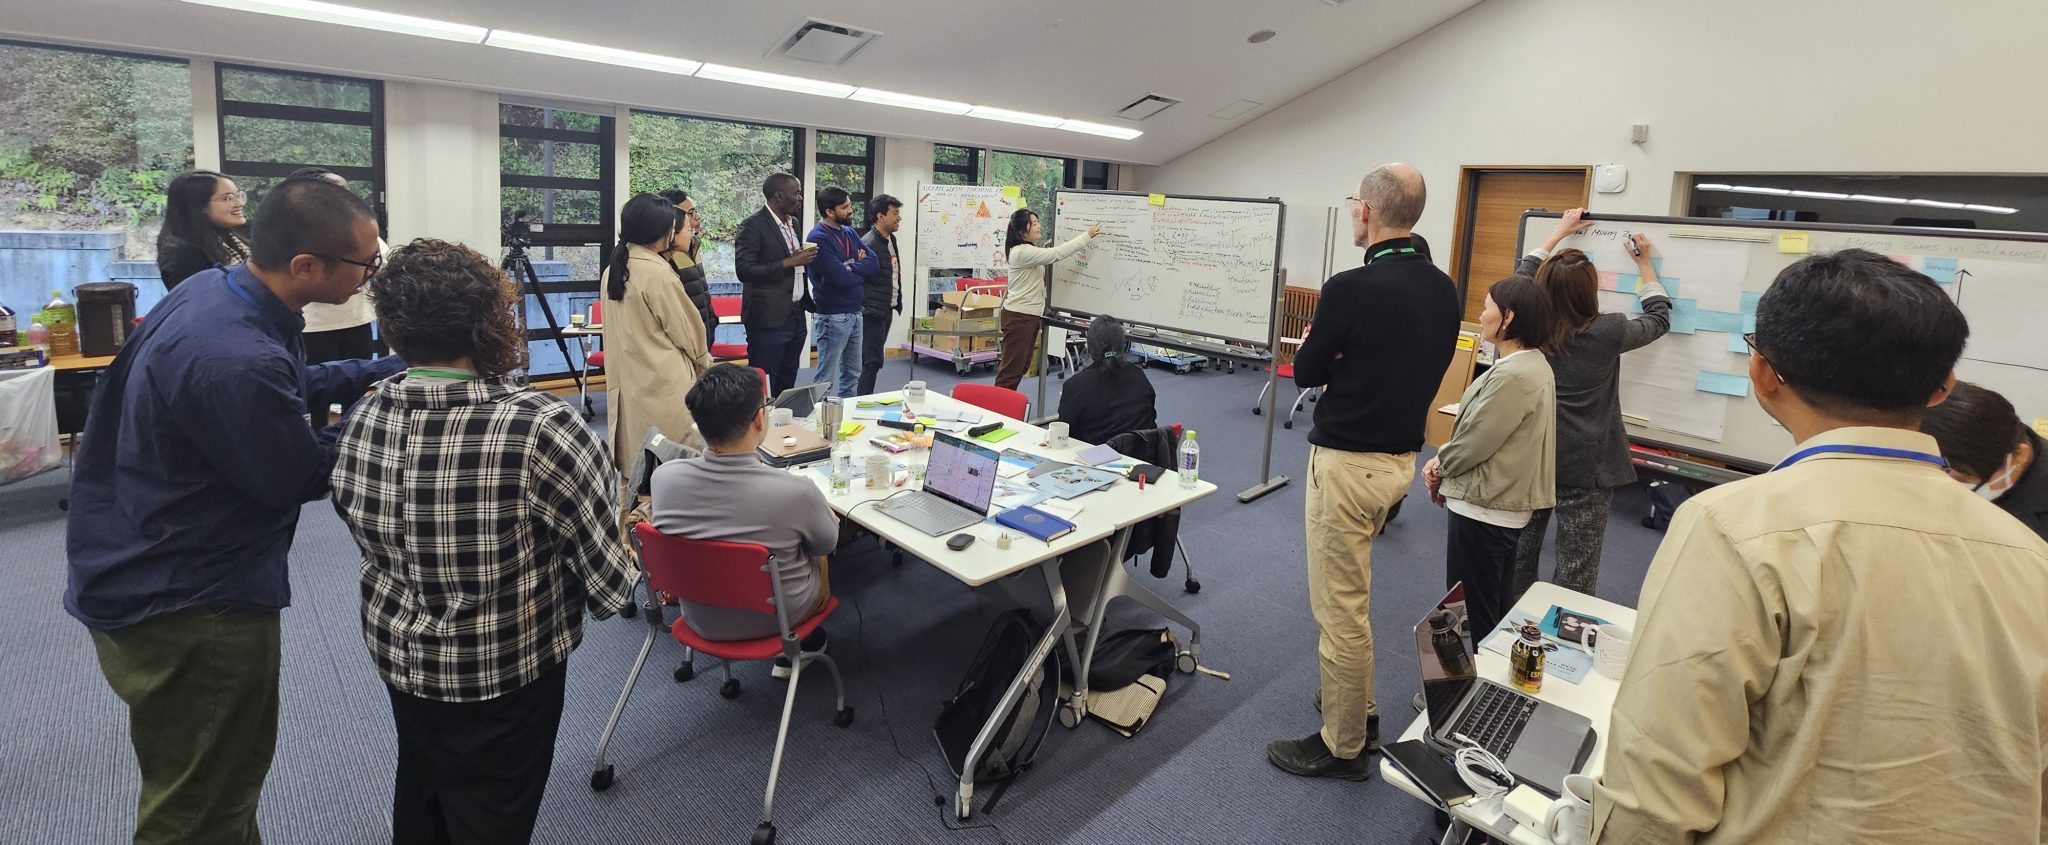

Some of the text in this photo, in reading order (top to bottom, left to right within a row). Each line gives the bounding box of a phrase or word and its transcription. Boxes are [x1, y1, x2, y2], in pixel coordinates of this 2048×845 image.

[1591, 228, 1618, 241] Mining
[1903, 241, 1940, 252] Zones
[1974, 243, 2048, 260] Sulawesi
